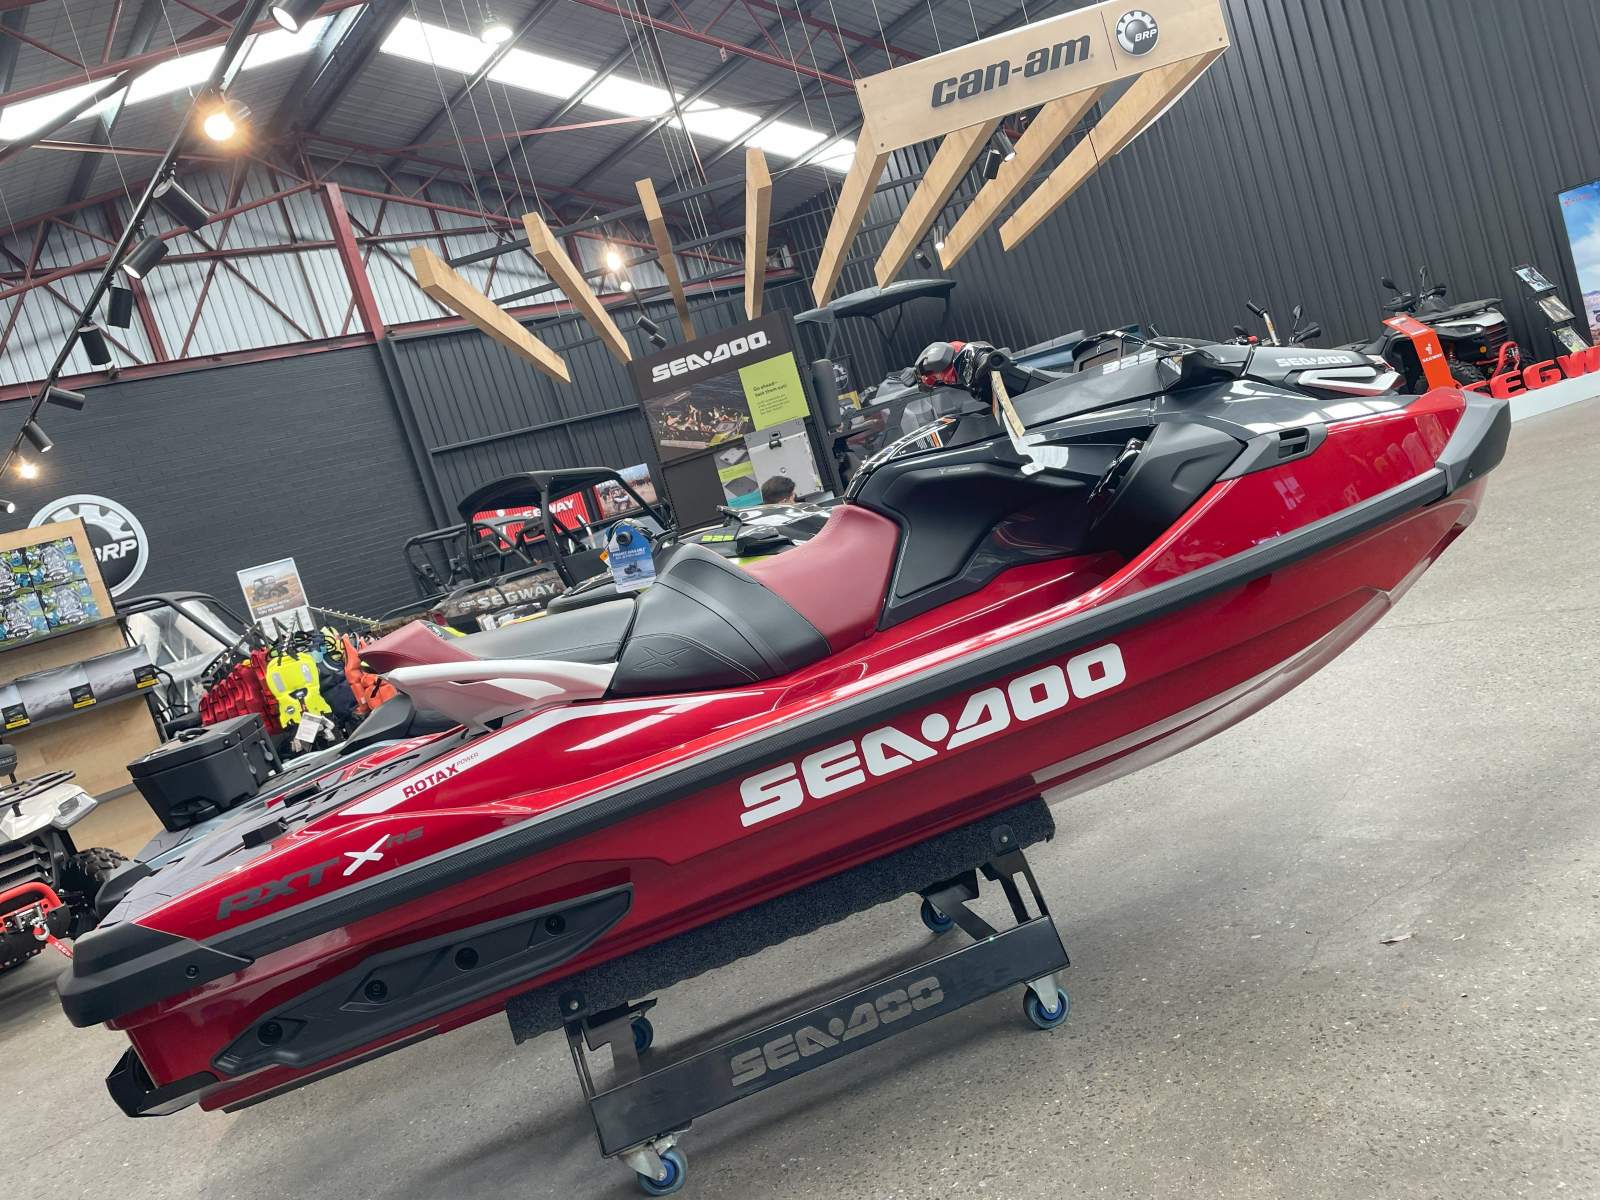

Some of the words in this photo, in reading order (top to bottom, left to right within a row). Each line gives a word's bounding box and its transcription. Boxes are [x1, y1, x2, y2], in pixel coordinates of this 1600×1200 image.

[1134, 28, 1158, 43] BRP
[931, 34, 1092, 109] can-am
[477, 583, 556, 609] SEGWAY
[402, 763, 459, 798] ROTAX
[456, 752, 479, 767] POWER
[216, 856, 341, 920] RXT
